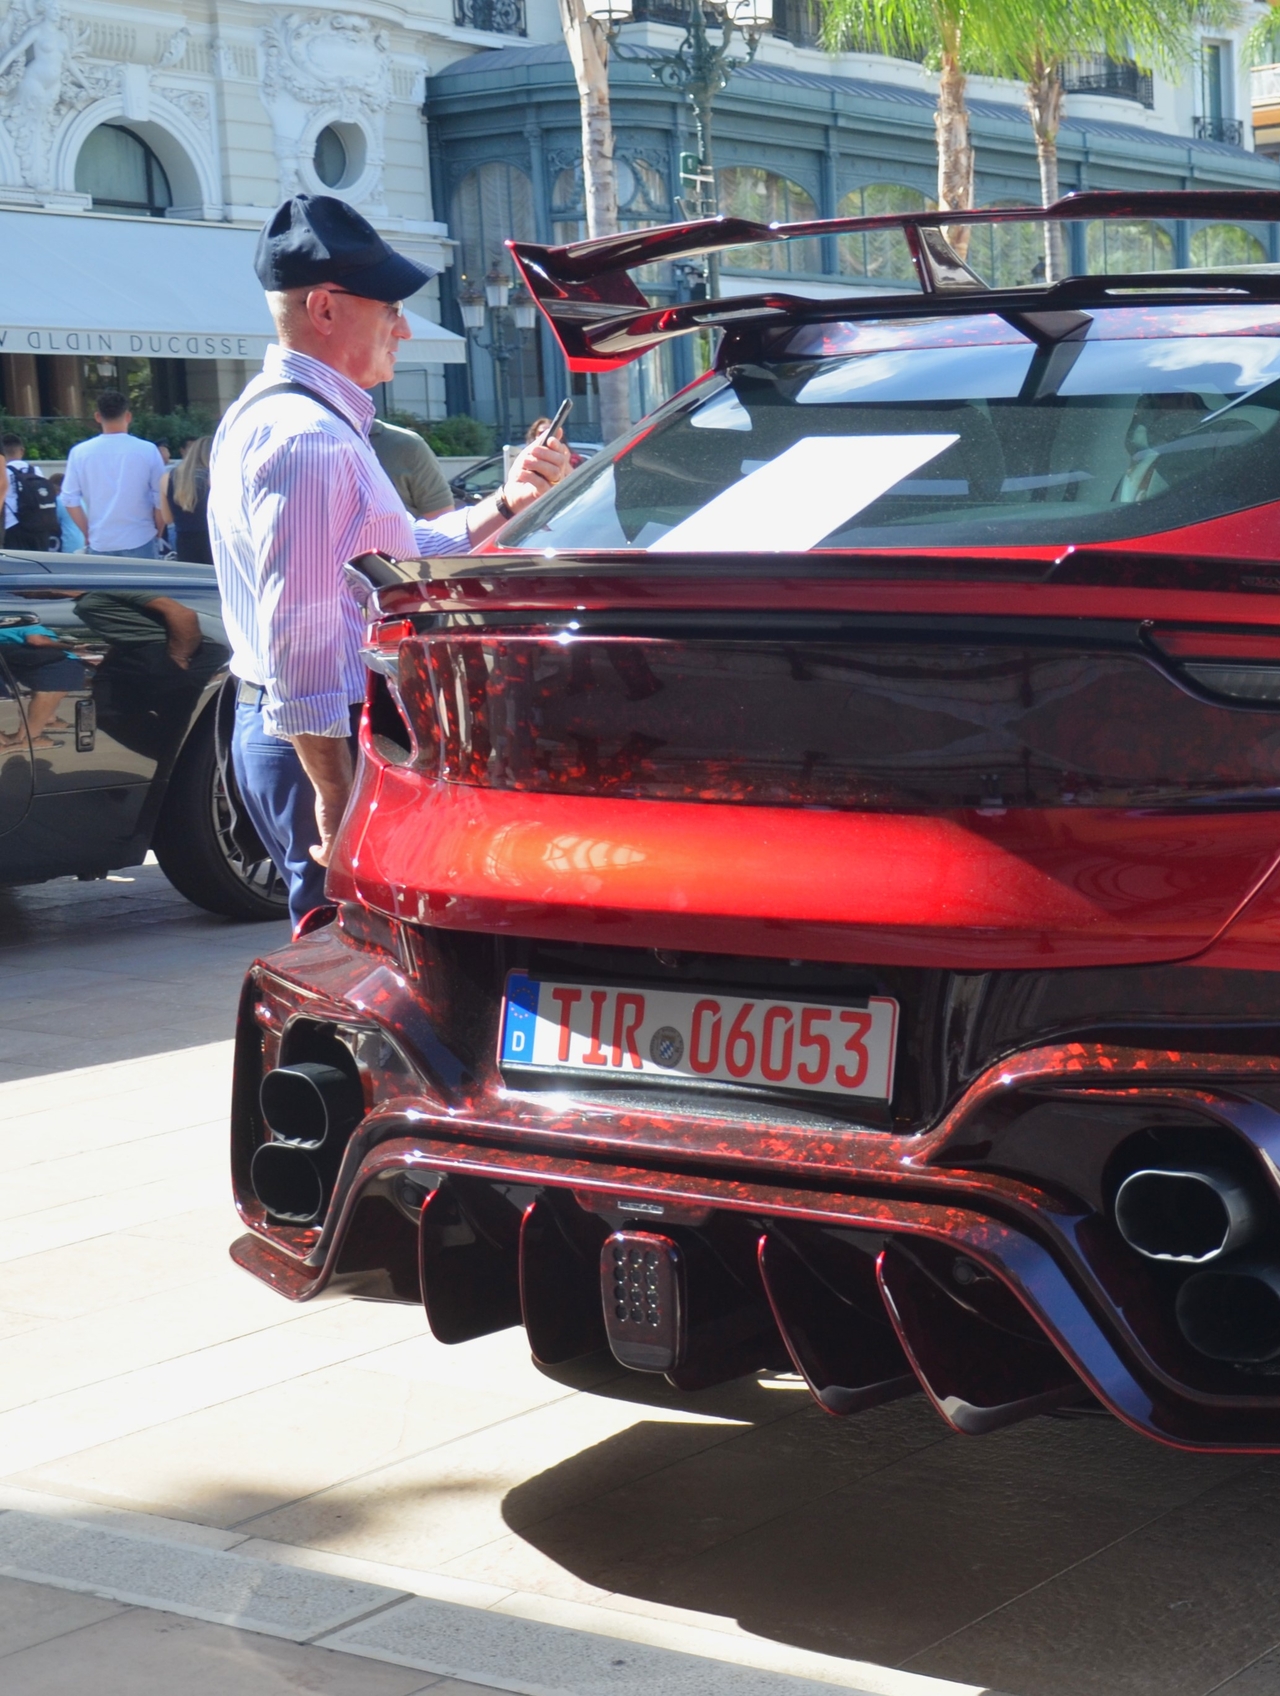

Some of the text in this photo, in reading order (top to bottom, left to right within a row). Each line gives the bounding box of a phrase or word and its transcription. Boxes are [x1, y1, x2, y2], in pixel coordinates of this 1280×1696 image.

[27, 331, 112, 350] ALAIN
[130, 335, 248, 355] DUCASSE
[511, 1030, 525, 1052] D
[552, 987, 645, 1069] TIR
[689, 999, 873, 1088] 06053
